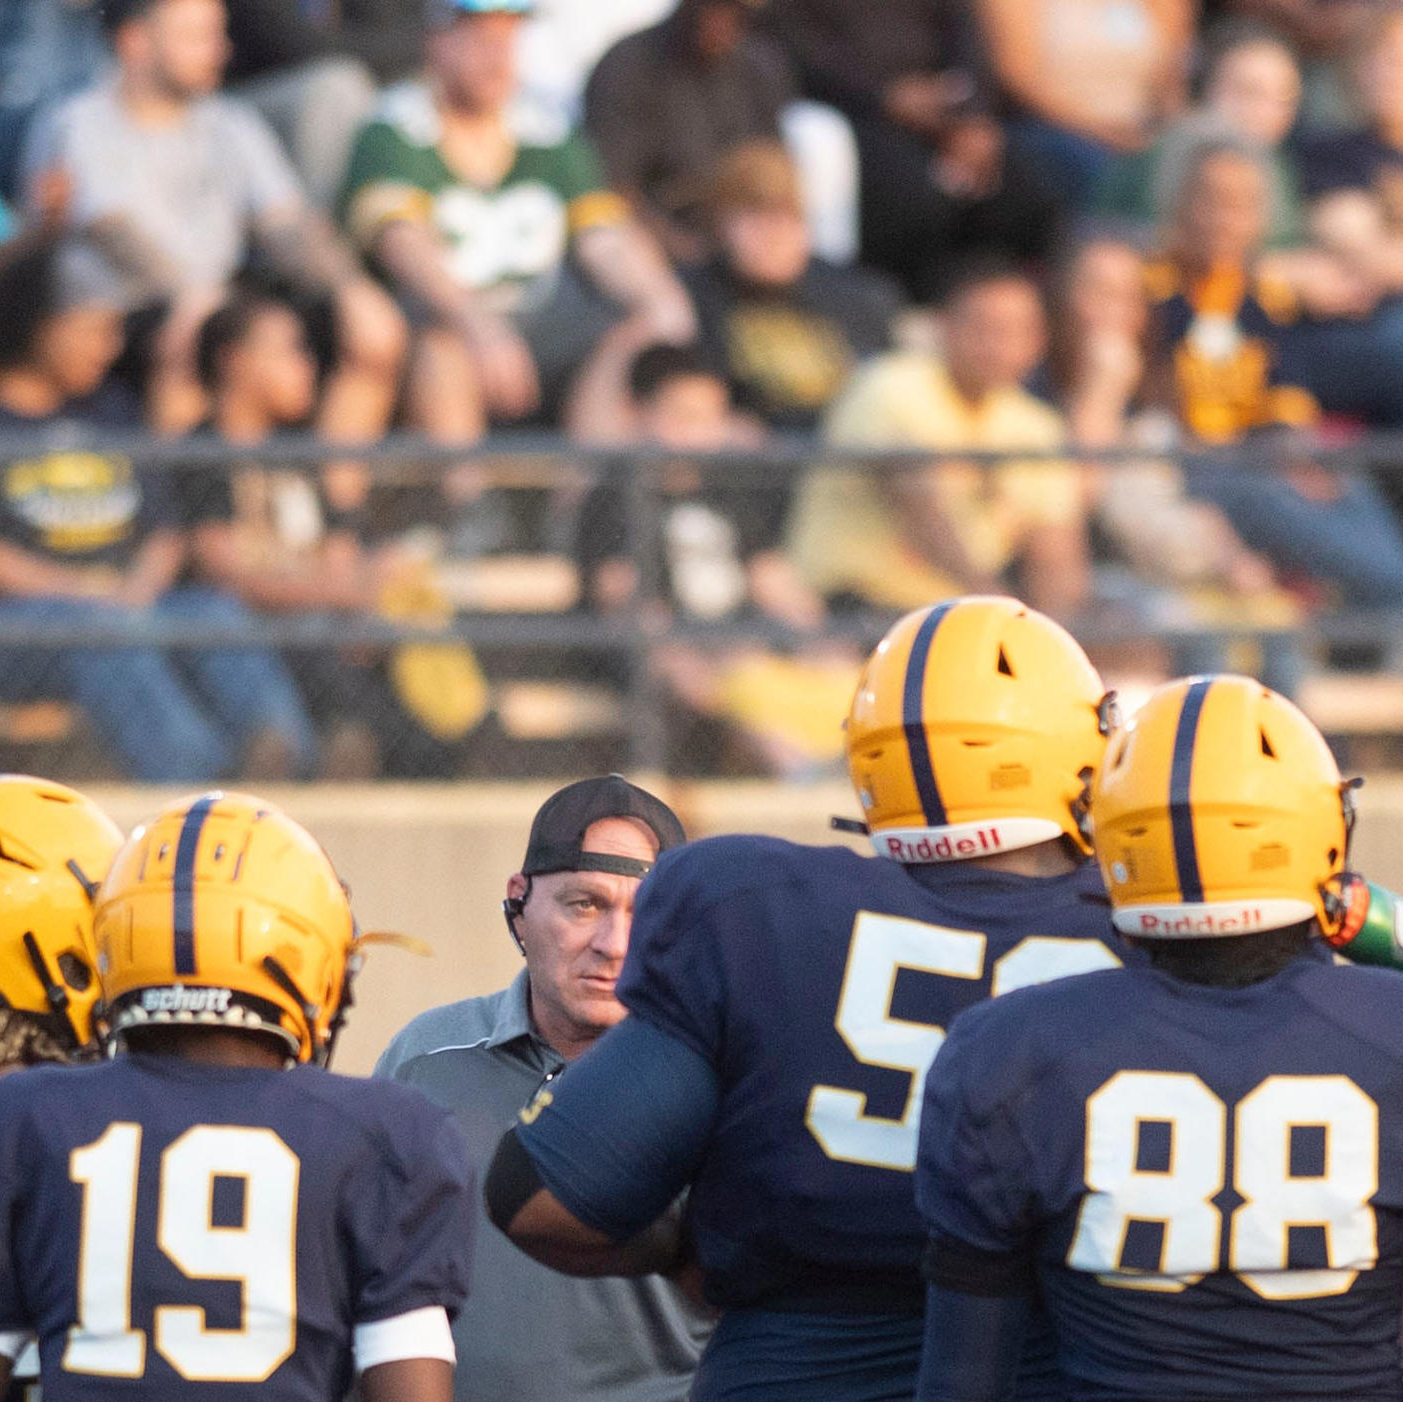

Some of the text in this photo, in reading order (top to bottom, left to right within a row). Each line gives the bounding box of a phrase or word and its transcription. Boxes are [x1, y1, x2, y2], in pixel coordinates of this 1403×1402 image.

[886, 828, 1002, 861] Riddell
[141, 982, 233, 1012] schutt
[805, 910, 1124, 1173] 5
[60, 1121, 301, 1381] 19
[1065, 1069, 1380, 1300] 88
